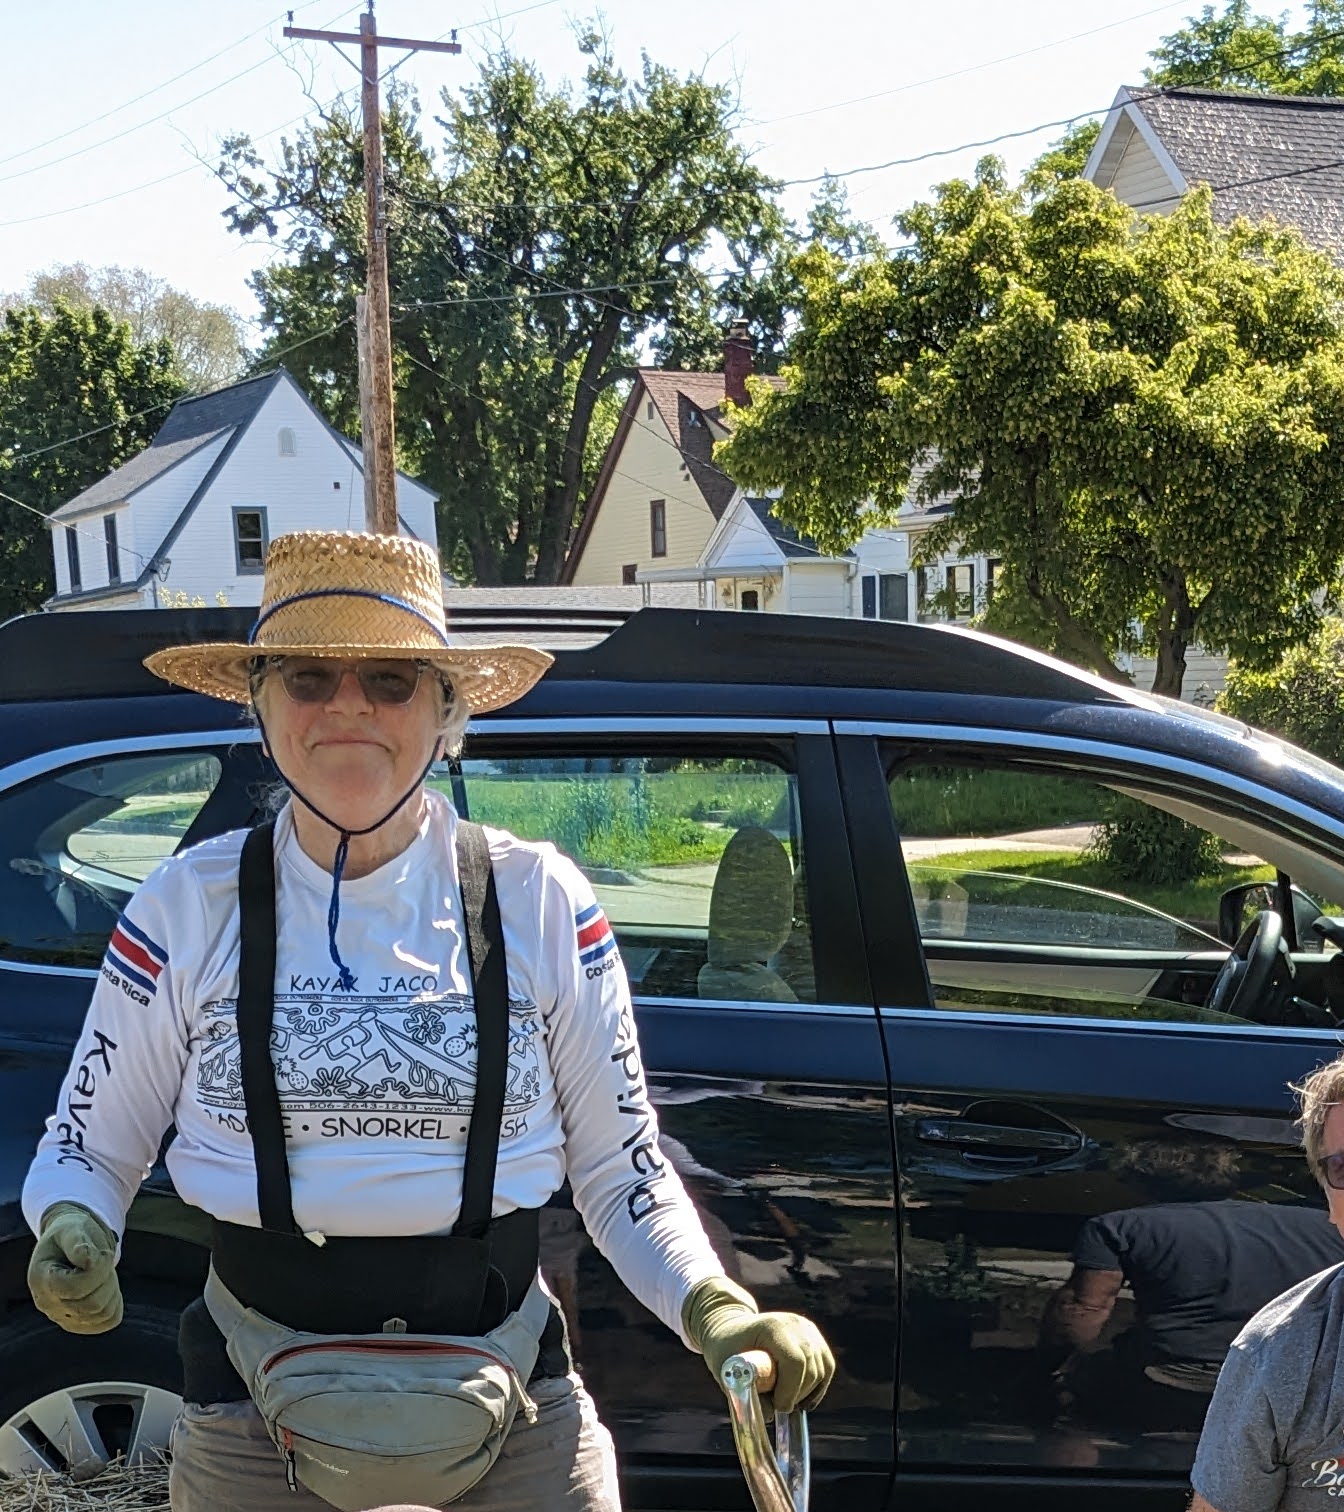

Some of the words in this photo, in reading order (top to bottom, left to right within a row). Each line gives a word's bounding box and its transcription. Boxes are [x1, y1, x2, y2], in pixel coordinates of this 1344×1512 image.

[585, 958, 615, 980] Costa
[101, 965, 120, 987] osta
[122, 979, 151, 1007] Rica
[290, 975, 360, 993] KAYAK
[379, 974, 438, 993] JACO
[321, 1116, 450, 1140] SNORKEL
